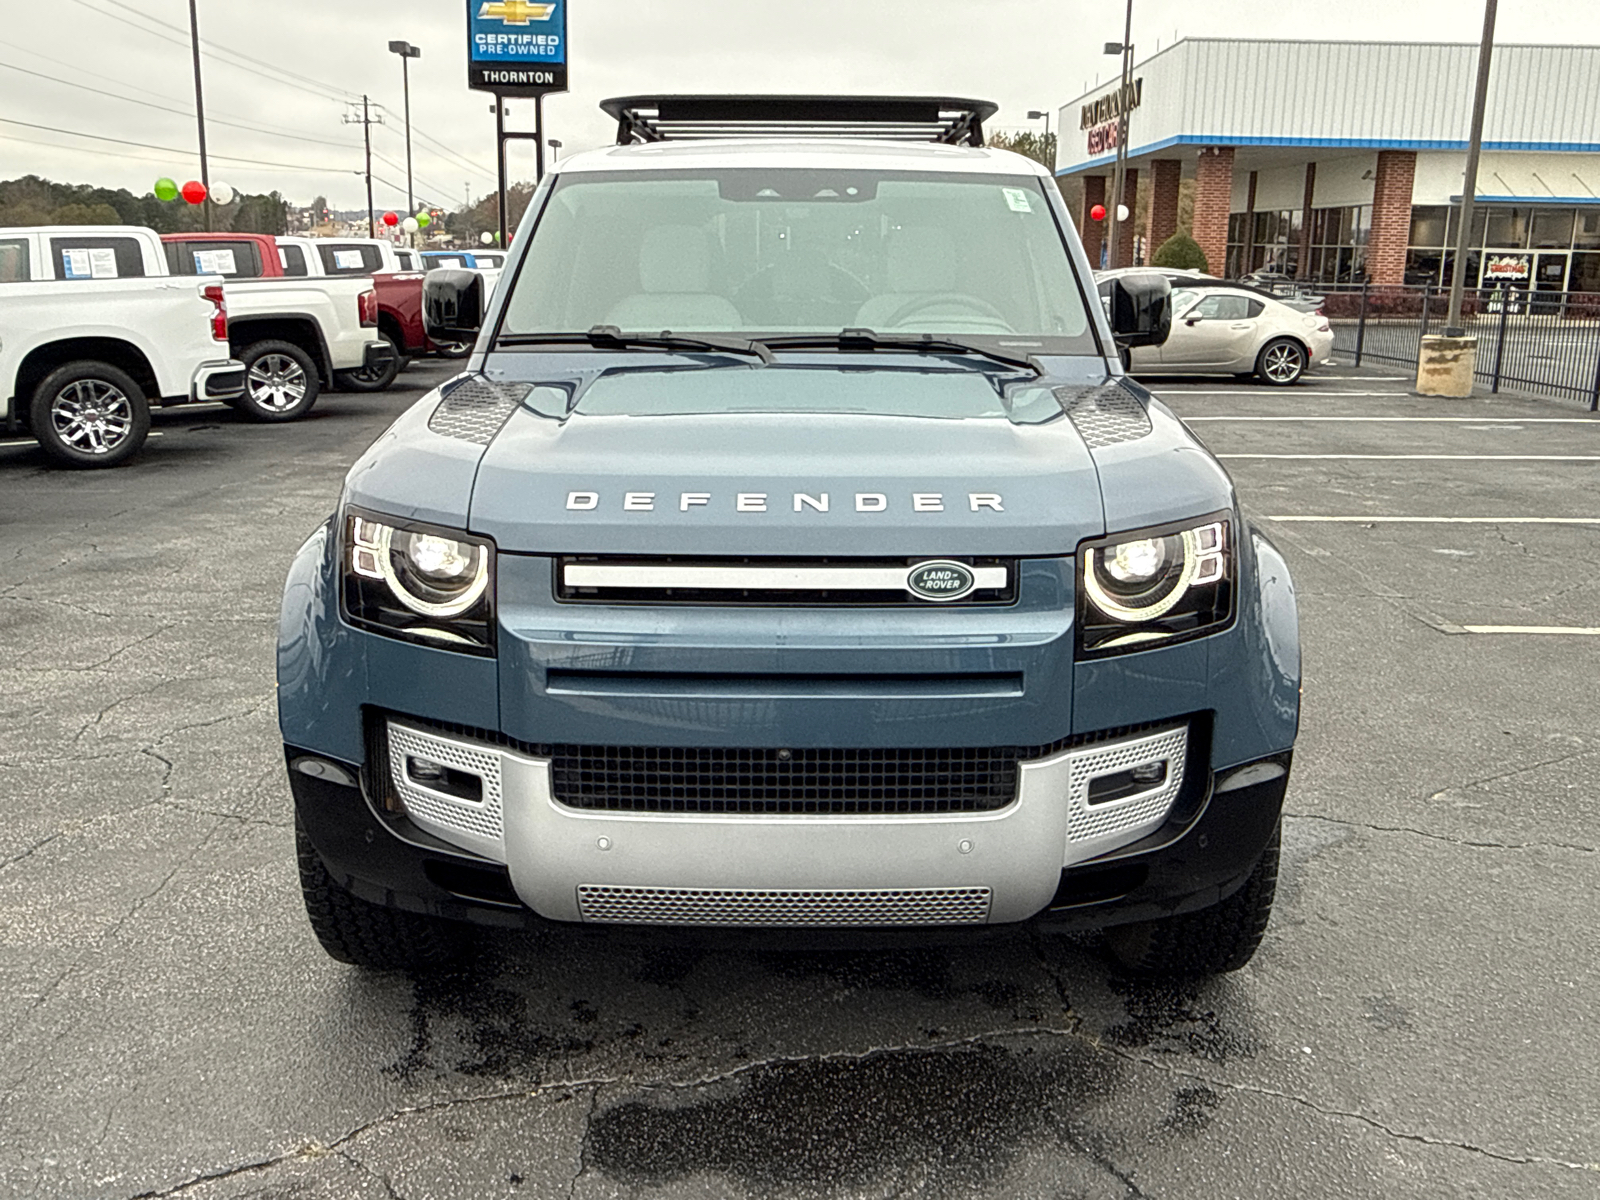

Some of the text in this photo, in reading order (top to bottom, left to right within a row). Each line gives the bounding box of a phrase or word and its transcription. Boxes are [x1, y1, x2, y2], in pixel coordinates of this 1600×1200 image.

[475, 34, 559, 45] CERTIFIED
[479, 45, 555, 55] PRE-OWNED
[482, 71, 554, 83] THORNTON
[1098, 77, 1143, 123] THORNON
[565, 491, 1004, 512] DEFENDER
